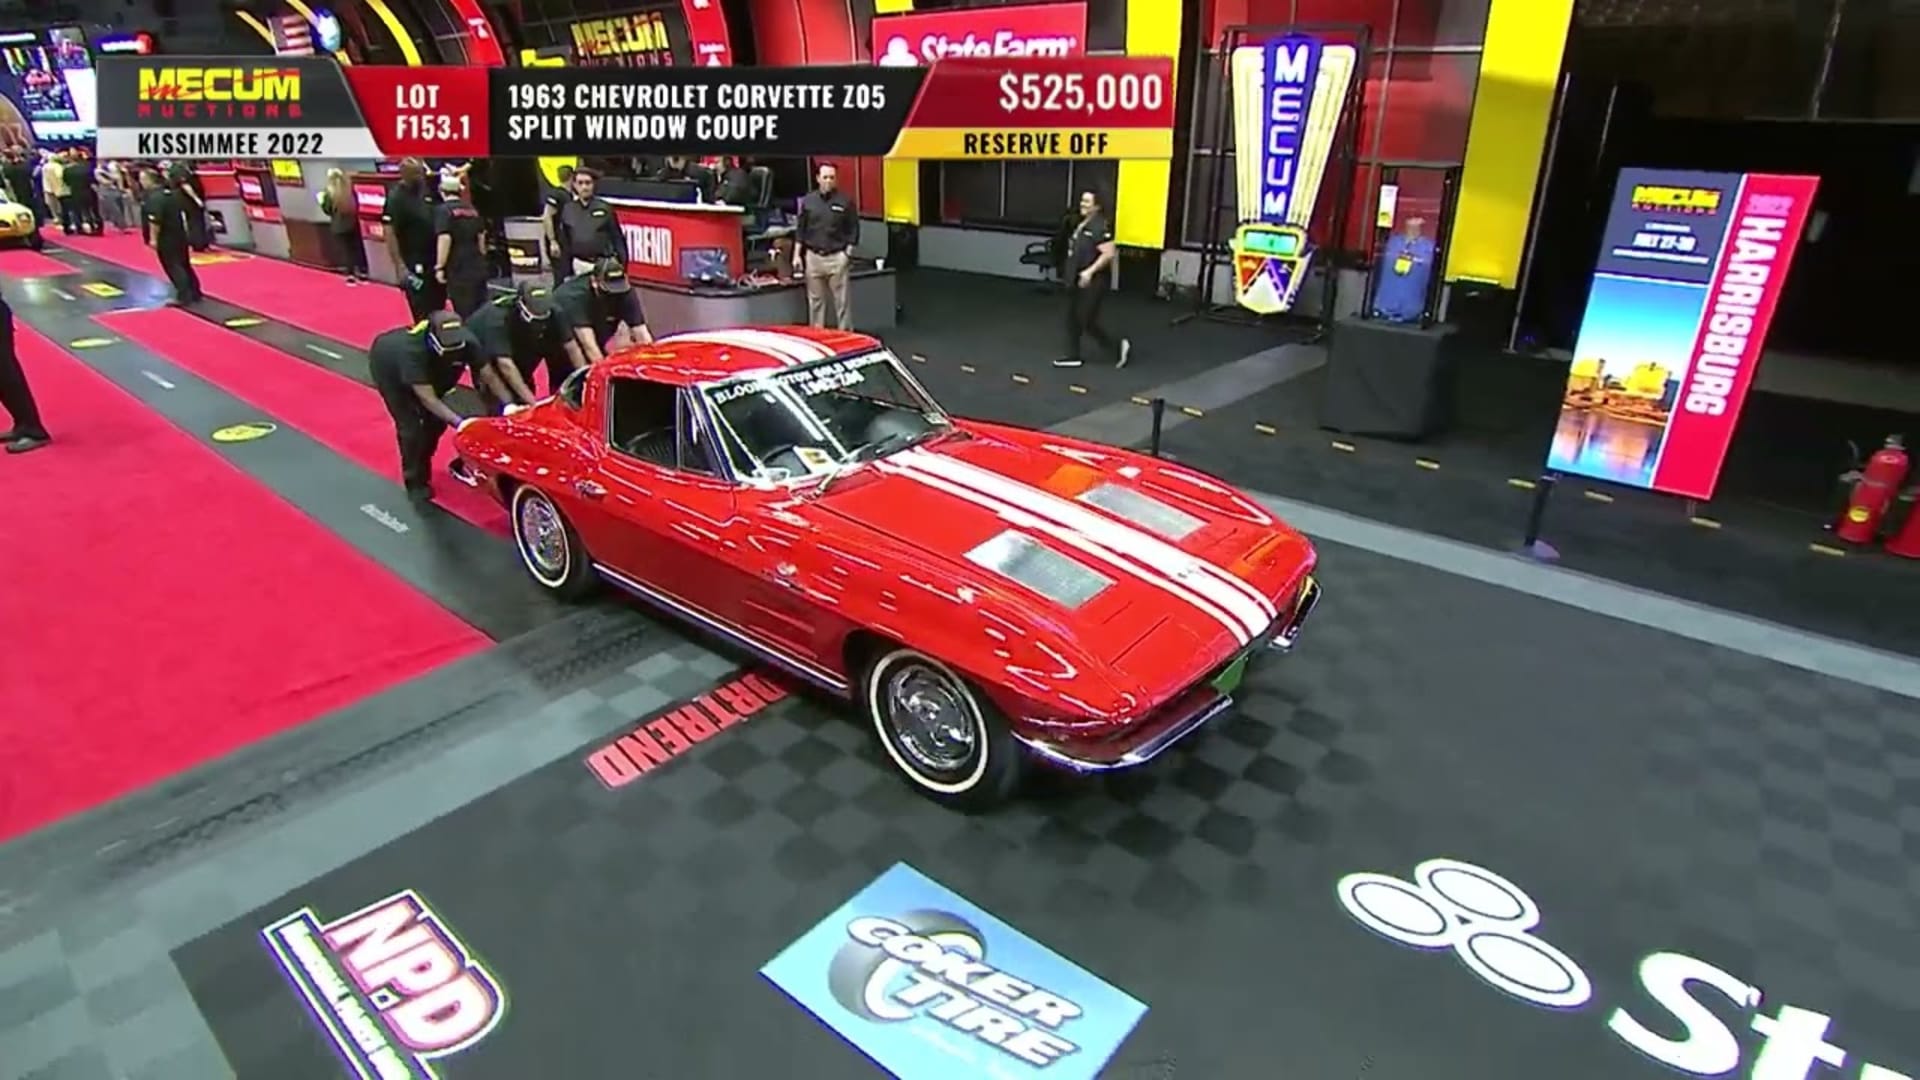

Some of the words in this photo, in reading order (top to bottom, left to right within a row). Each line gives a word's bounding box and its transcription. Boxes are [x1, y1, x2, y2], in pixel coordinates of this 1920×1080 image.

[571, 12, 669, 57] MECUM
[1263, 44, 1310, 217] MECUM
[620, 224, 672, 267] TREND
[1684, 216, 1787, 415] HARRISBURG
[585, 672, 788, 788] ORTREND
[323, 894, 494, 1051] NPD
[847, 915, 1084, 1030] COKER
[889, 970, 1082, 1069] TIRE
[1607, 950, 1914, 1080] St
